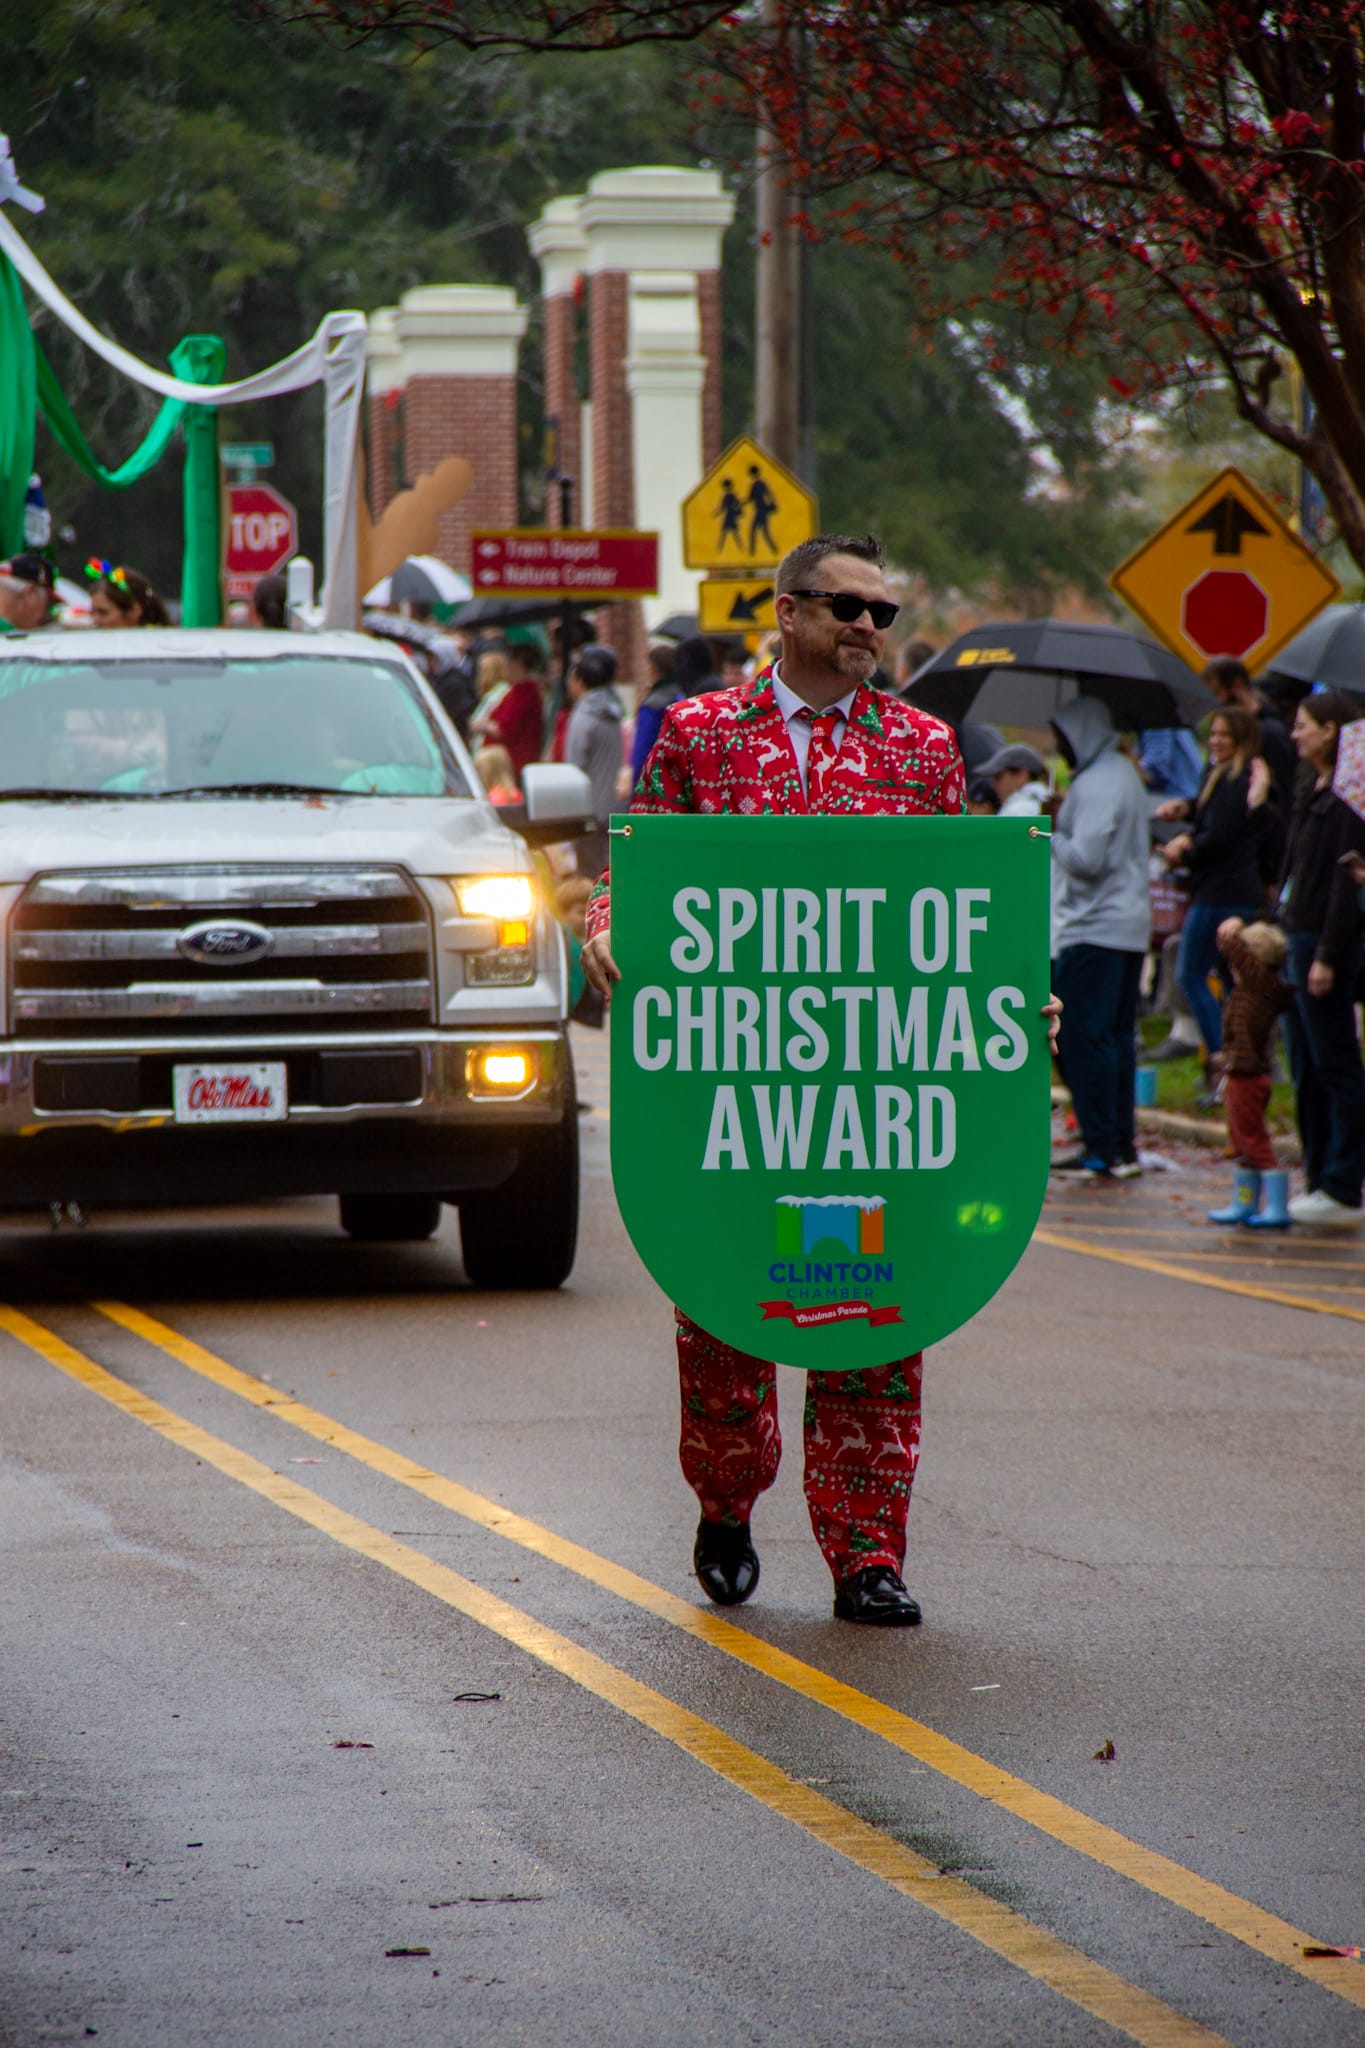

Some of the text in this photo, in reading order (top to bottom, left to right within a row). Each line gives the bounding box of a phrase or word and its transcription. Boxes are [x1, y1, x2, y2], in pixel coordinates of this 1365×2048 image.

[230, 512, 290, 551] TOP
[505, 537, 600, 564] Train Depot
[503, 564, 618, 586] Nature Center
[202, 929, 251, 953] Ford
[670, 887, 991, 974] SPIRIT OF
[632, 985, 1030, 1072] CHRISTMAS
[187, 1076, 273, 1110] Ole Miss
[701, 1085, 957, 1170] AWARD
[768, 1262, 893, 1283] CLINTON
[786, 1287, 875, 1299] CHAMBER
[796, 1305, 869, 1324] Christmas Parade
